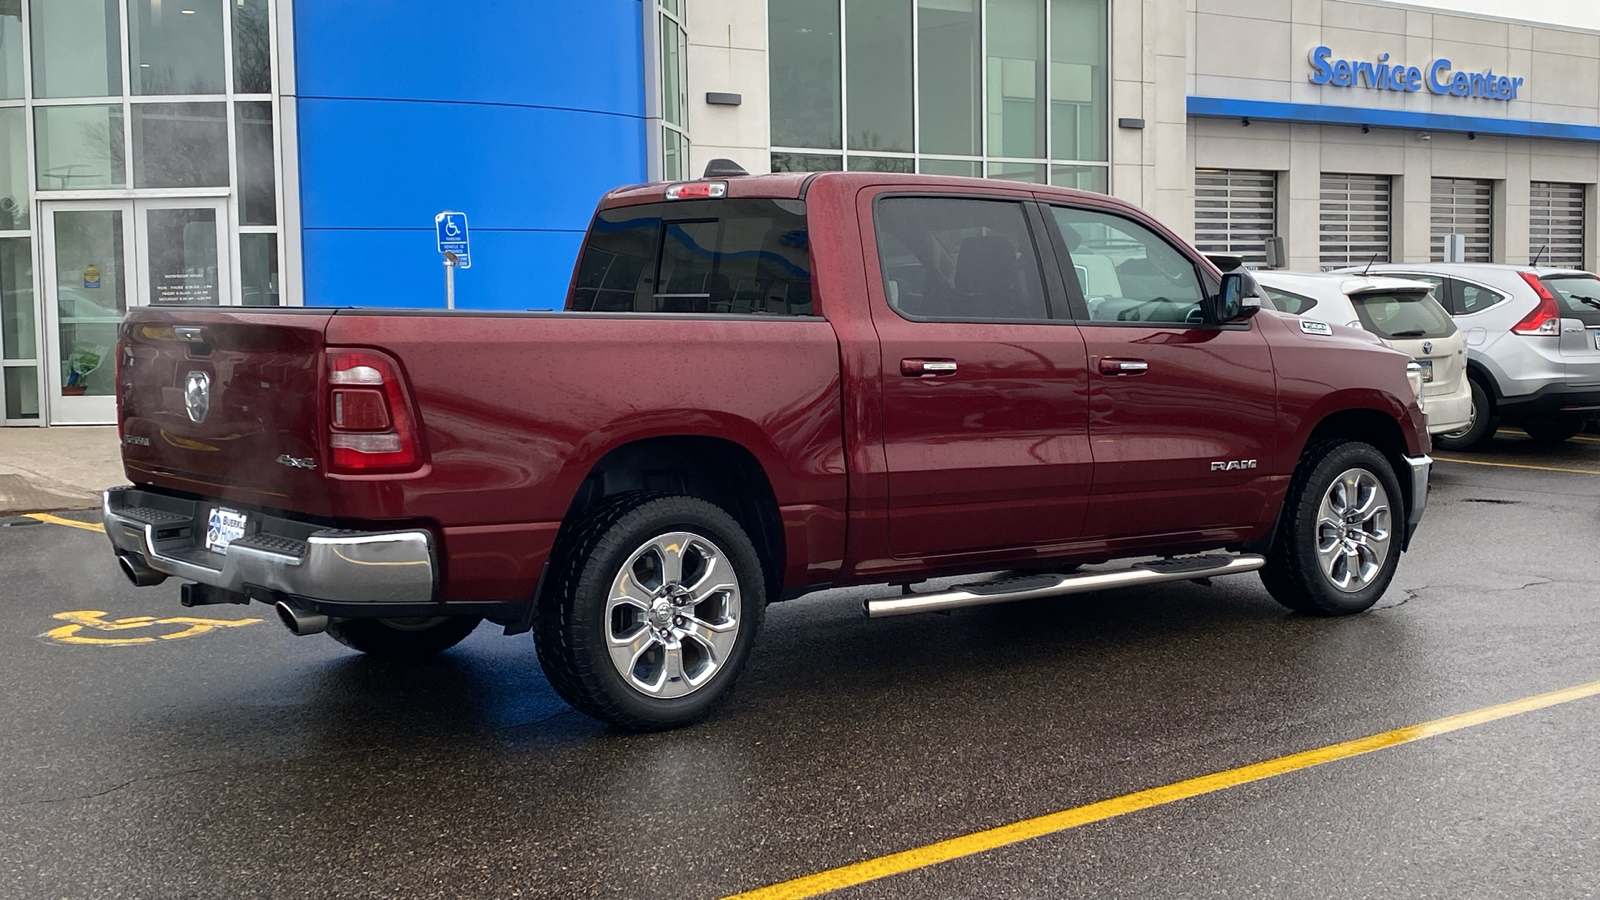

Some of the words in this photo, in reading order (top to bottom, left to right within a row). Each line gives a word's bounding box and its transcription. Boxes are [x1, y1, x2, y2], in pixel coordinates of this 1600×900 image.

[1309, 45, 1422, 93] Service
[1426, 58, 1524, 100] Center
[1211, 460, 1257, 471] RAM
[220, 526, 245, 543] HOND
